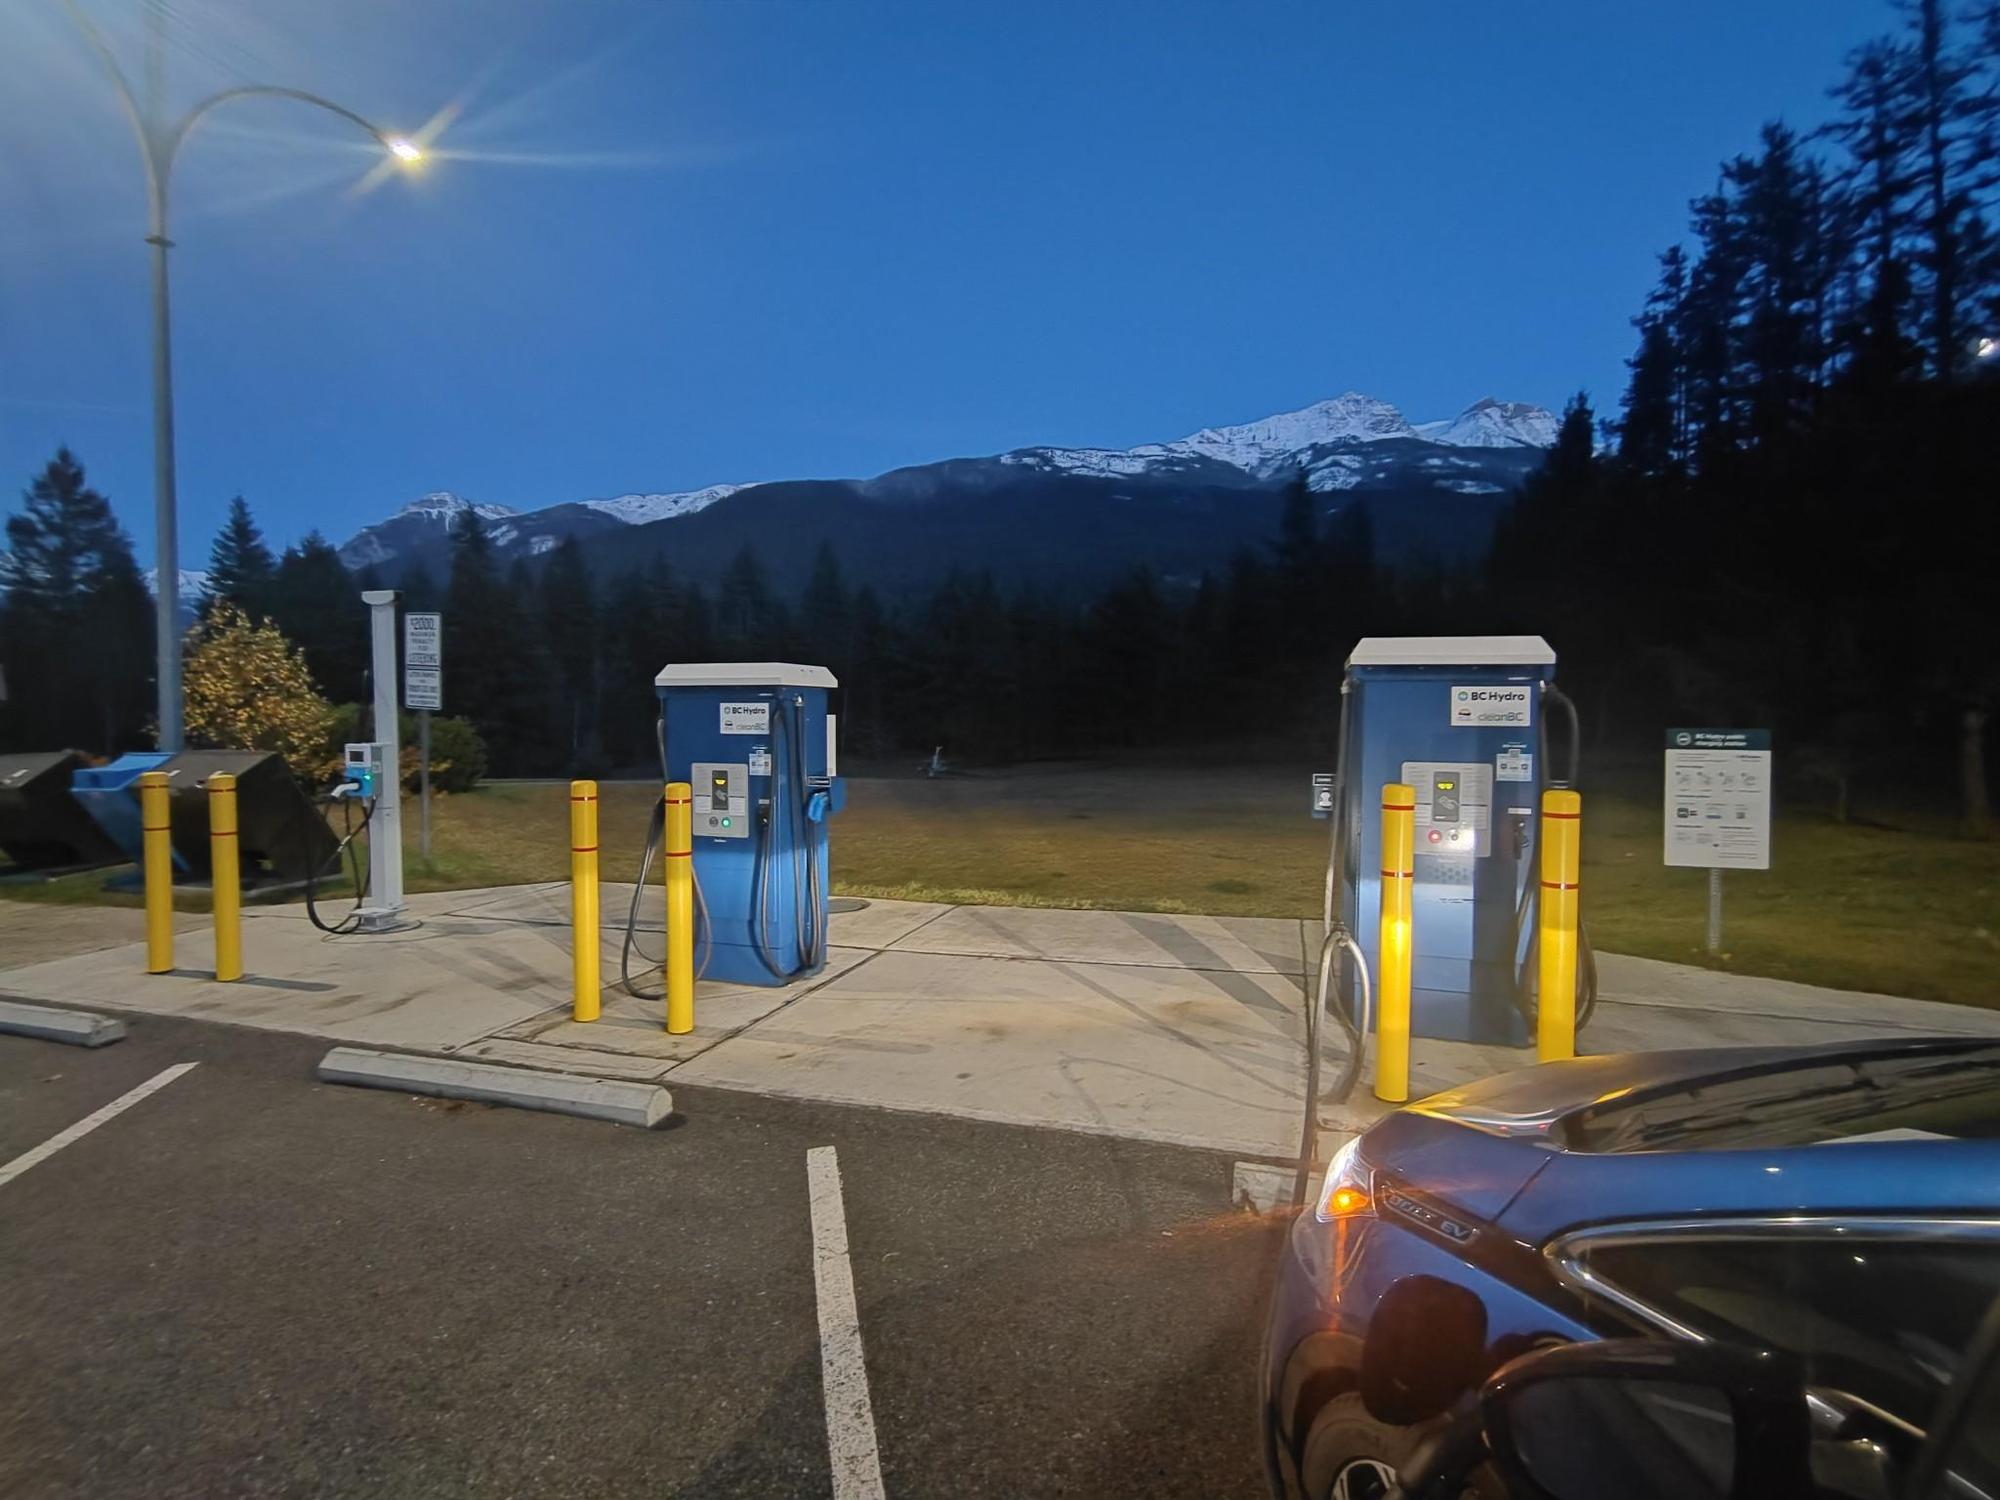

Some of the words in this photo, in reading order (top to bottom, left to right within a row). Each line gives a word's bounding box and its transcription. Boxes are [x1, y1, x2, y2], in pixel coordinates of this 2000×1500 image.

[1471, 692, 1487, 701] BC
[1489, 692, 1525, 702] Hydro
[732, 706, 743, 714] BC
[743, 706, 766, 715] Hydro
[1478, 711, 1524, 722] cleanBC
[1440, 1221, 1469, 1237] EV
